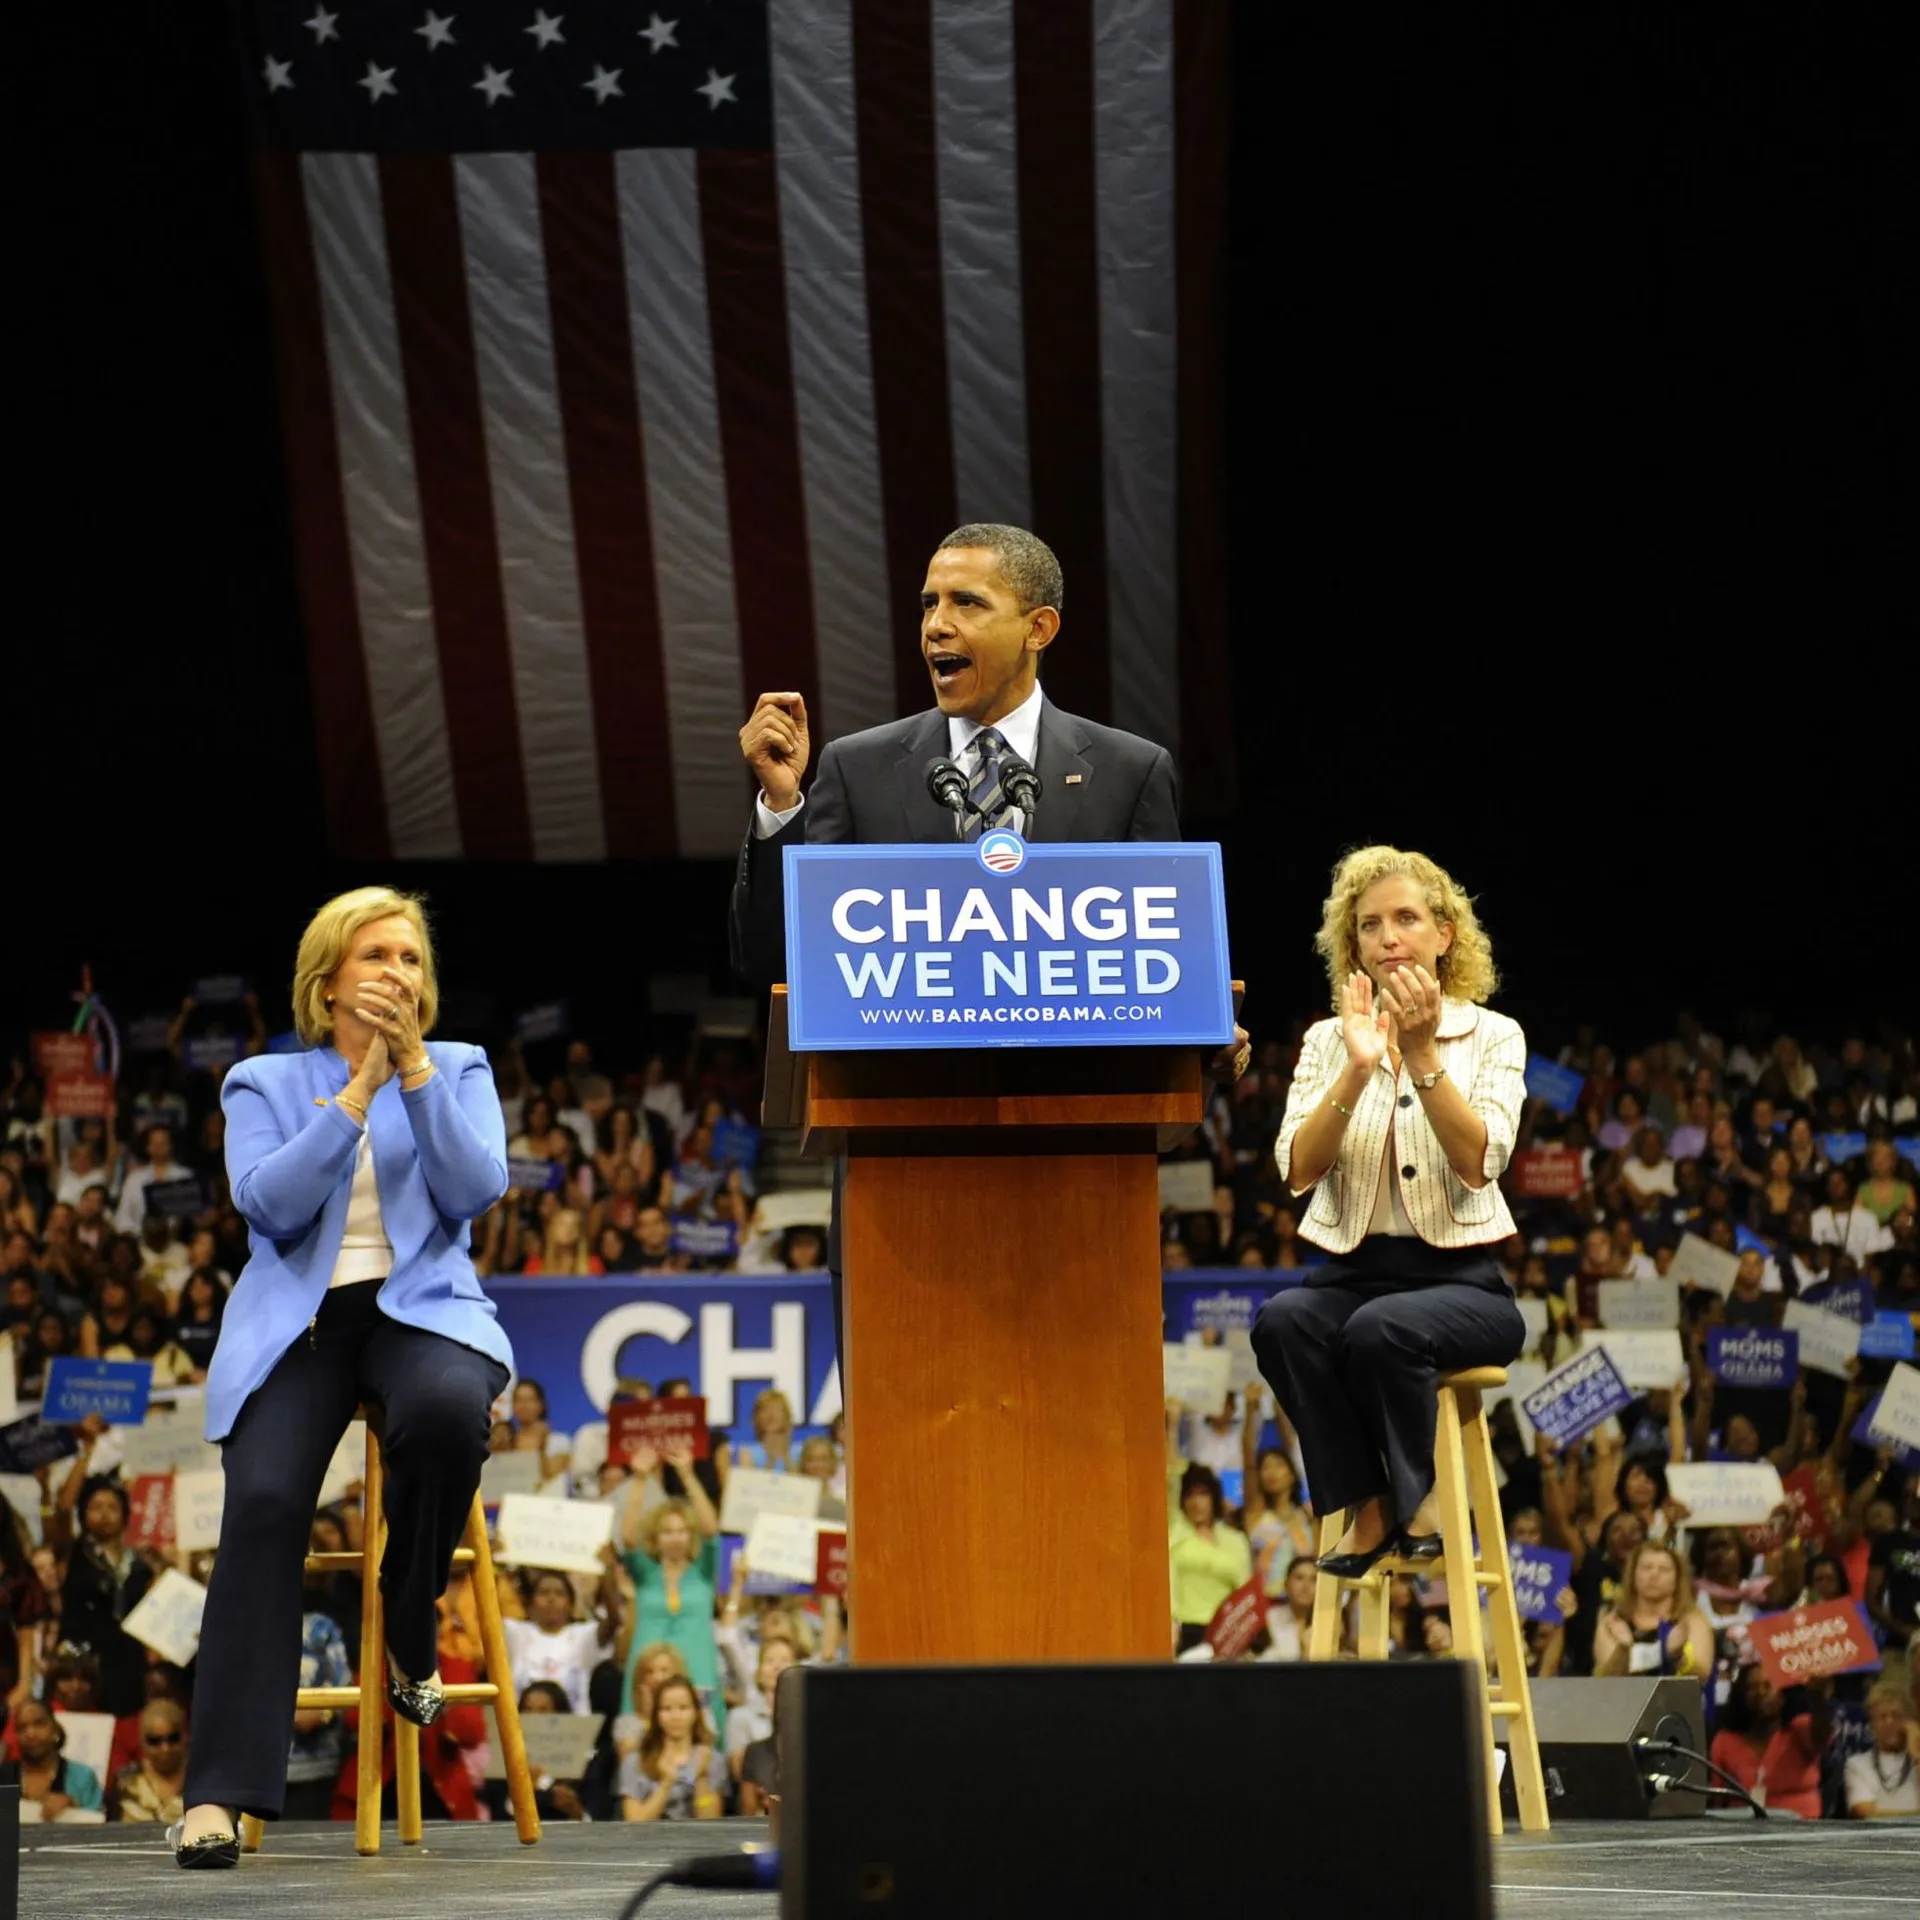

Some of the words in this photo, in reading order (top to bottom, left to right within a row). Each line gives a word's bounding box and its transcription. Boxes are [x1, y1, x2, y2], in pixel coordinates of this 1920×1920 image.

[831, 886, 1181, 944] CHANGE
[834, 951, 954, 998] WE
[982, 949, 1181, 996] NEED
[860, 1005, 1162, 1024] WWW.BARACKOBAMA.COM
[580, 1301, 843, 1426] CH
[1720, 1338, 1784, 1360] MOMS
[1720, 1360, 1784, 1379] OBAMA
